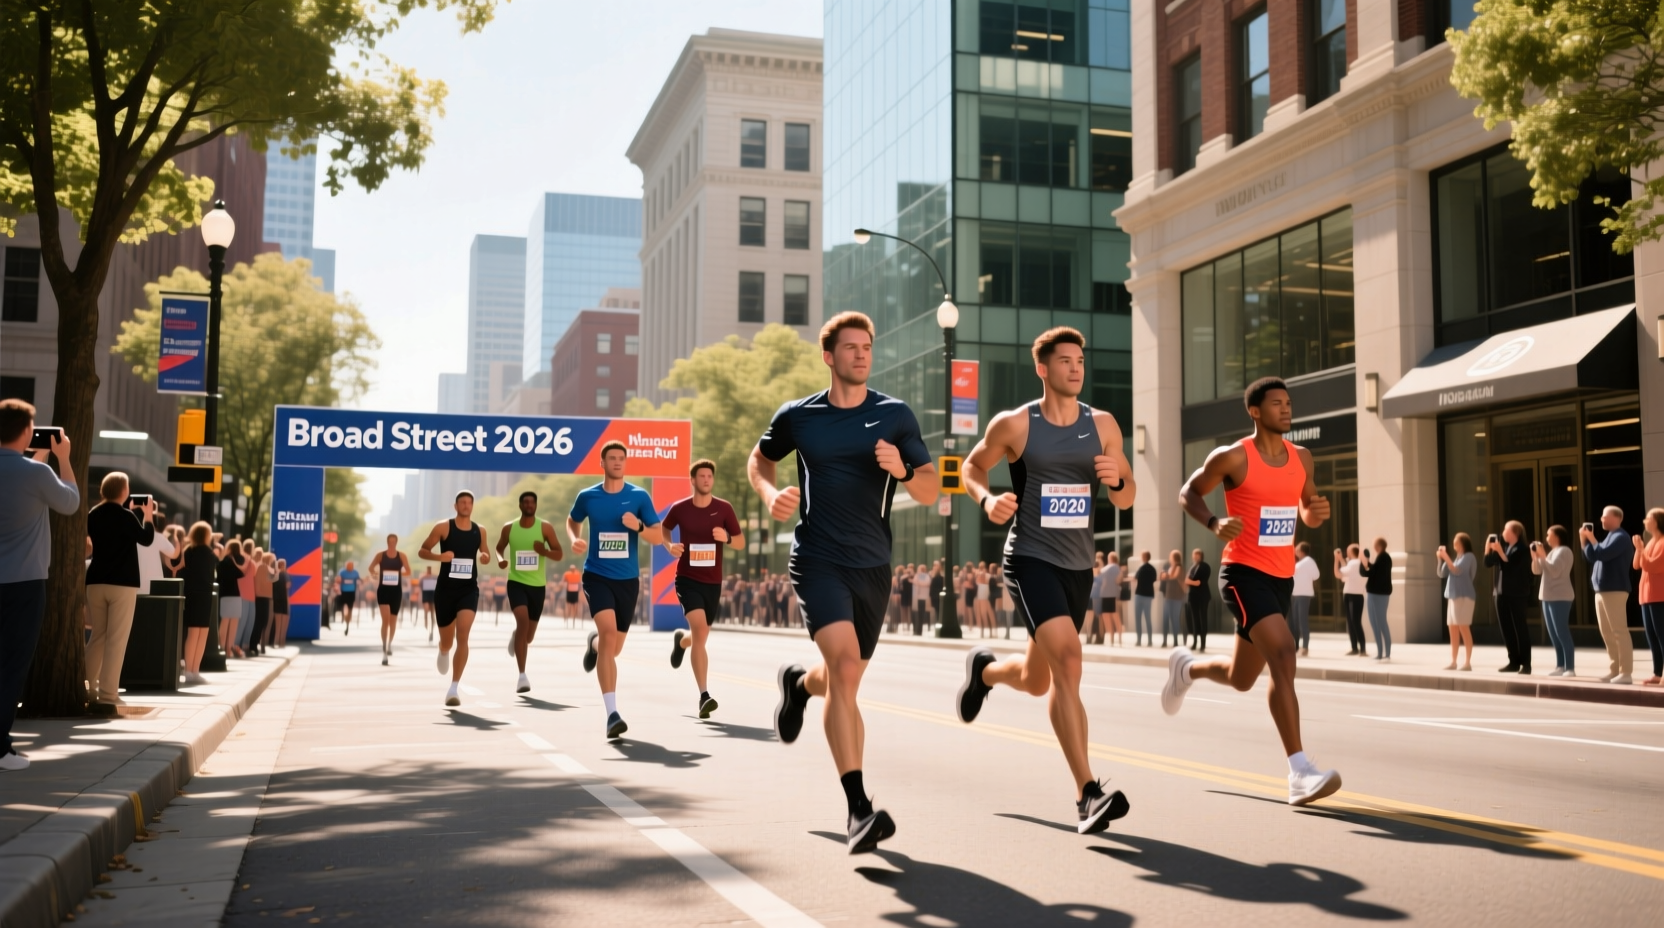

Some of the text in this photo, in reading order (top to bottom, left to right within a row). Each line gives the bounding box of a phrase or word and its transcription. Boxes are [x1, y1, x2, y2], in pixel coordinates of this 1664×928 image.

[288, 418, 573, 456] Broad Street 2026
